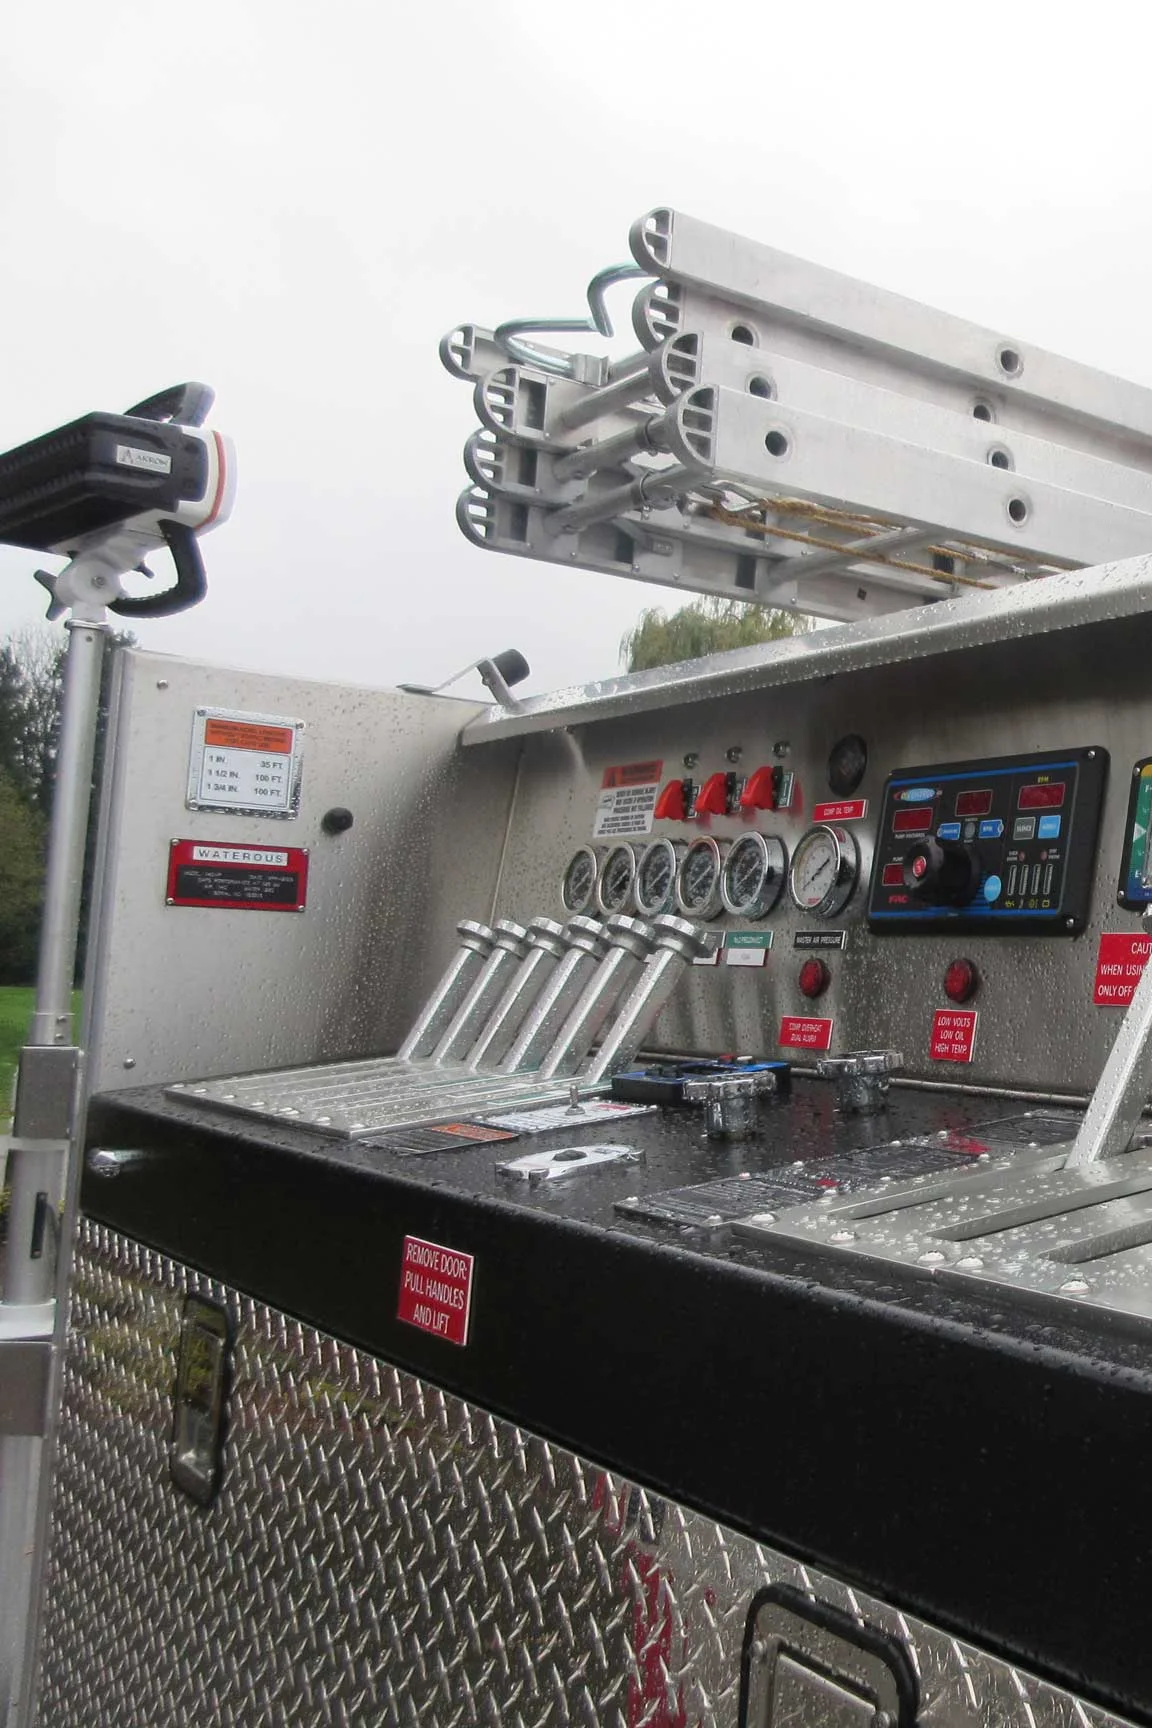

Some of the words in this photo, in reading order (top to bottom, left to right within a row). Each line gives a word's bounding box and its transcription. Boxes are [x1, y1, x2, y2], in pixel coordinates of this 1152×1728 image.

[256, 774, 270, 782] 100
[254, 788, 269, 796] 100
[198, 849, 285, 864] WATEROUS
[1100, 965, 1123, 975] WHEN
[1098, 985, 1117, 997] ONLY
[1118, 985, 1132, 997] OFF
[938, 1016, 951, 1027] LOW
[953, 1017, 970, 1027] VOLTS
[940, 1030, 954, 1040] LOW
[955, 1031, 964, 1041] OIL
[935, 1043, 949, 1053] HIGH
[405, 1242, 440, 1271] REMOVE
[404, 1270, 424, 1295] PULL
[425, 1277, 465, 1310] HANDLES
[413, 1303, 432, 1326] AND
[432, 1310, 450, 1334] LIFT
